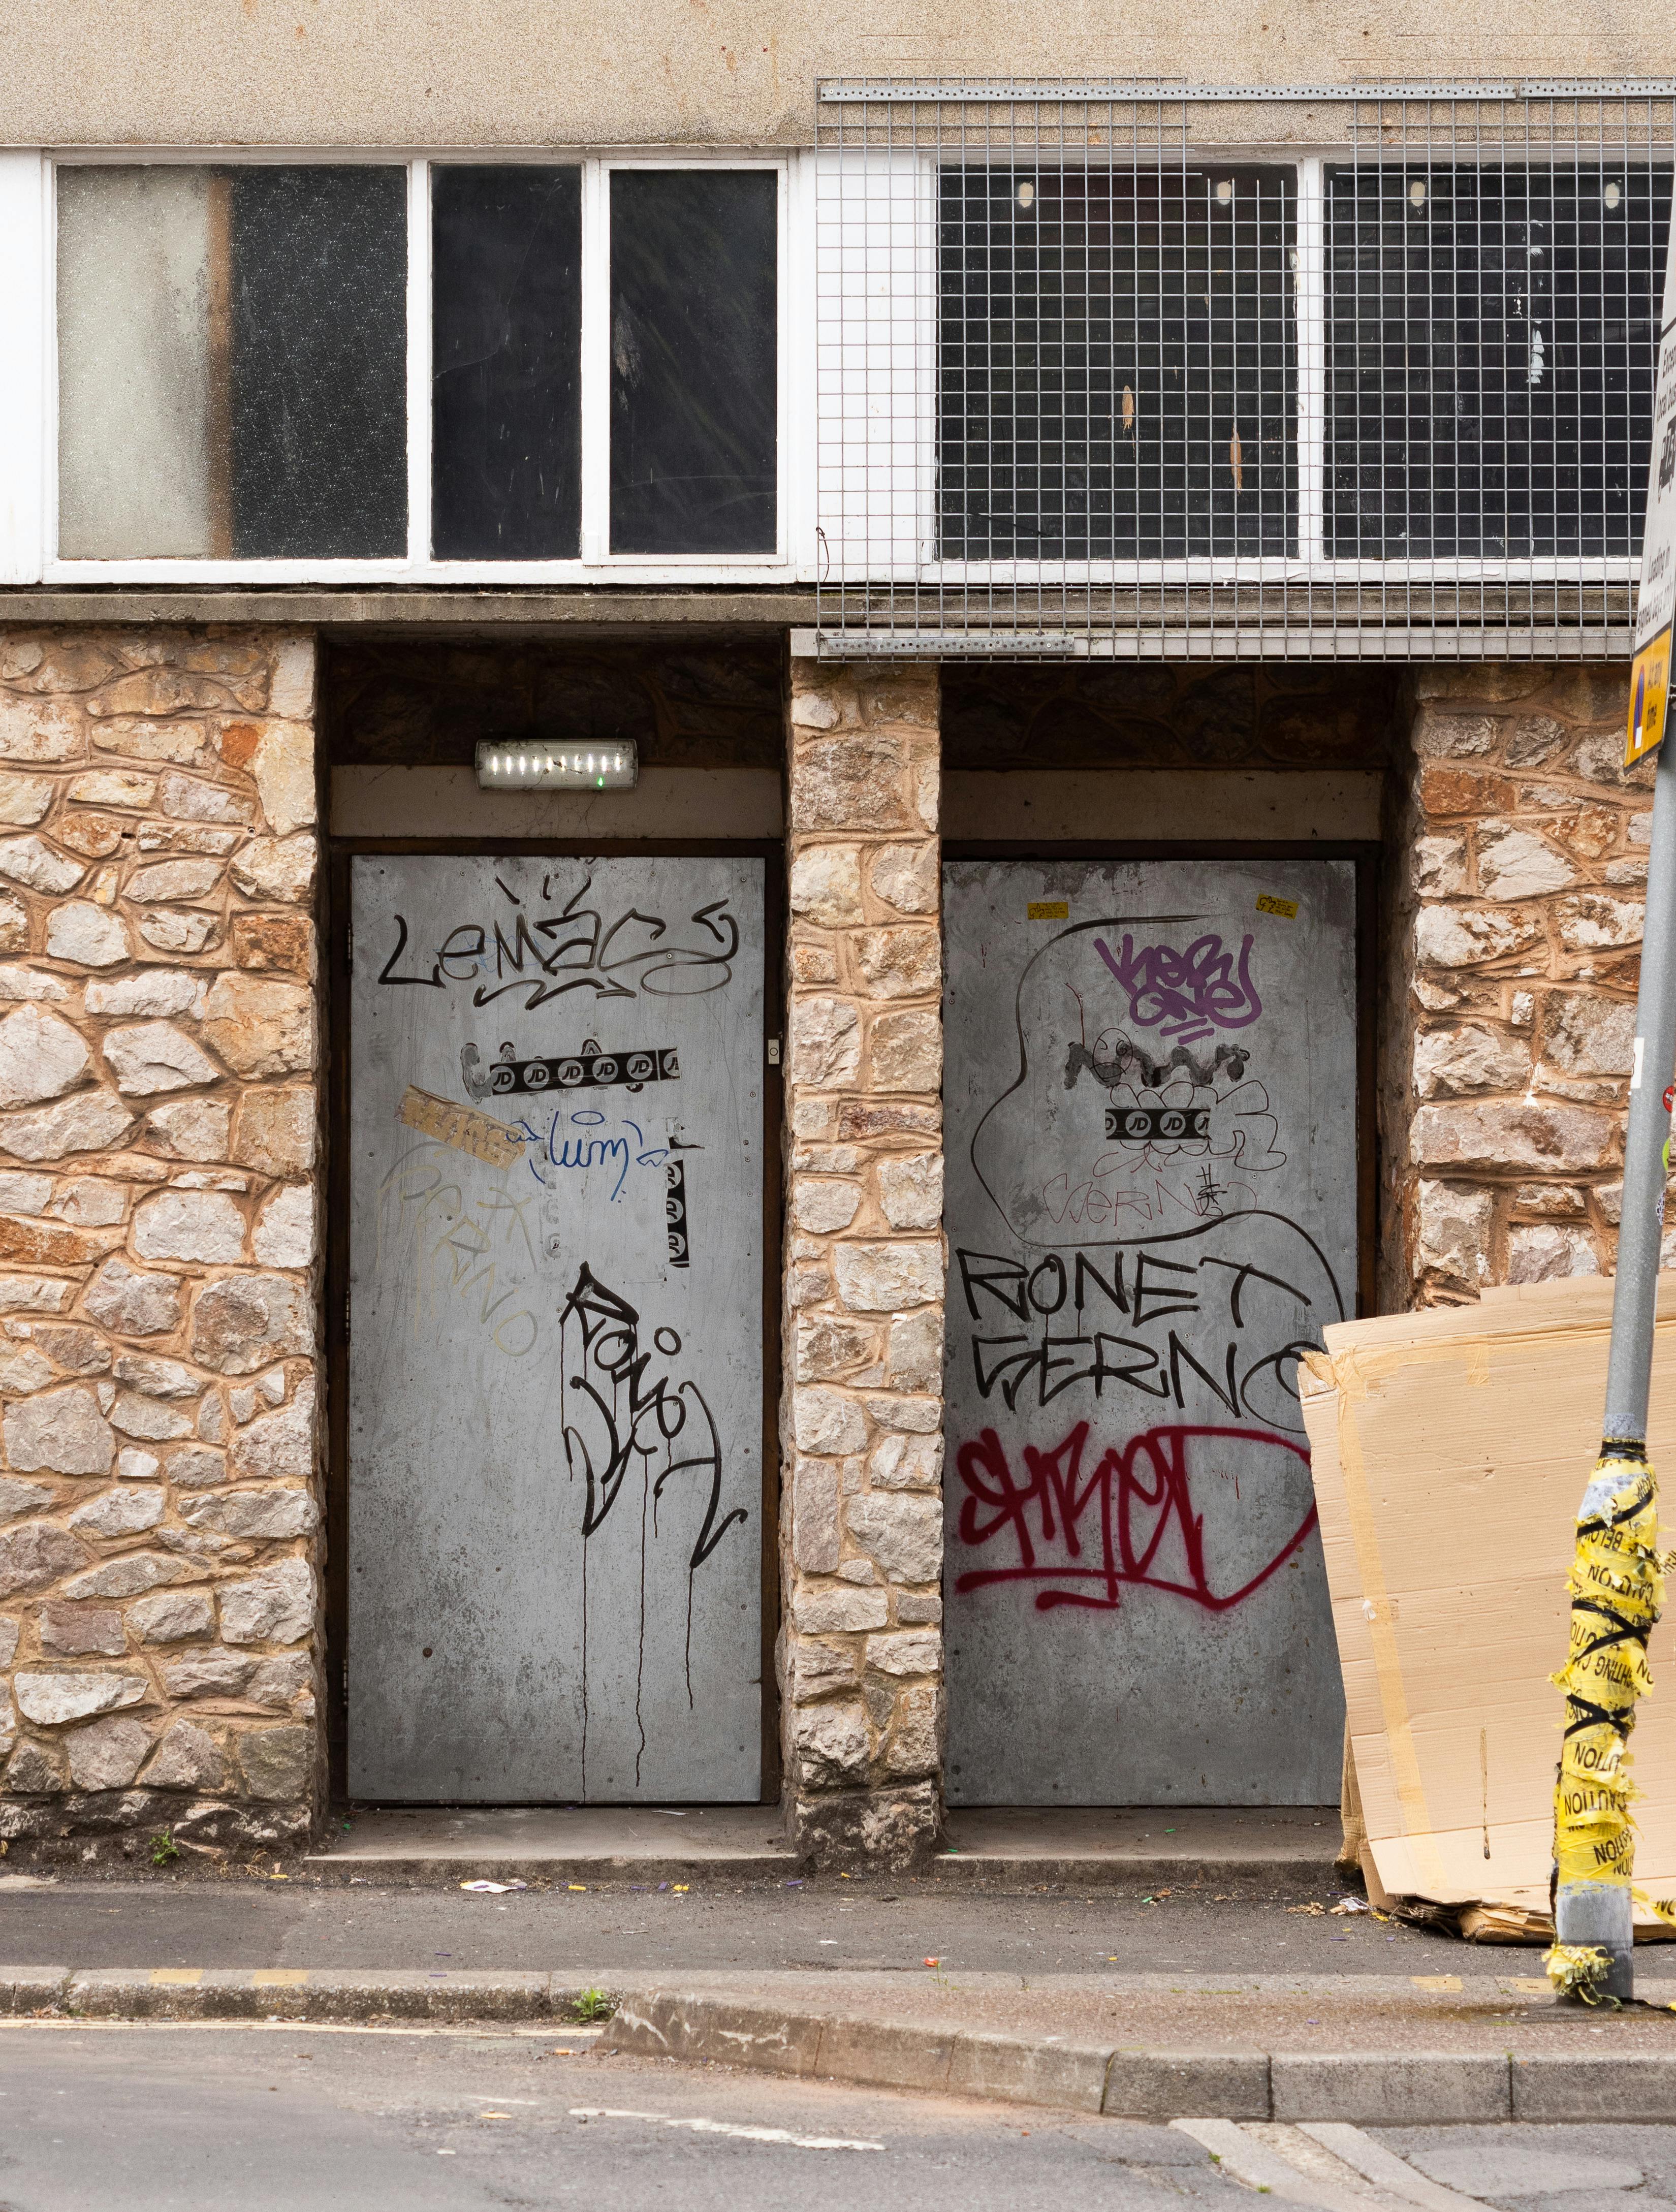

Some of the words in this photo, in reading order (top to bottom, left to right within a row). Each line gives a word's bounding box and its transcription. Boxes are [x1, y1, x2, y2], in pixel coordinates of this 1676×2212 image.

[1662, 344, 1676, 379] Excep
[1656, 384, 1668, 424] local
[1648, 547, 1665, 585] Loading
[1637, 592, 1653, 636] signed
[1652, 589, 1663, 621] bays
[1129, 1117, 1149, 1131] JD
[1163, 1117, 1183, 1131] JD
[1587, 1565, 1654, 1602] CAUTON
[1573, 1743, 1621, 1774] UTION
[1564, 1789, 1627, 1815] CAUTION
